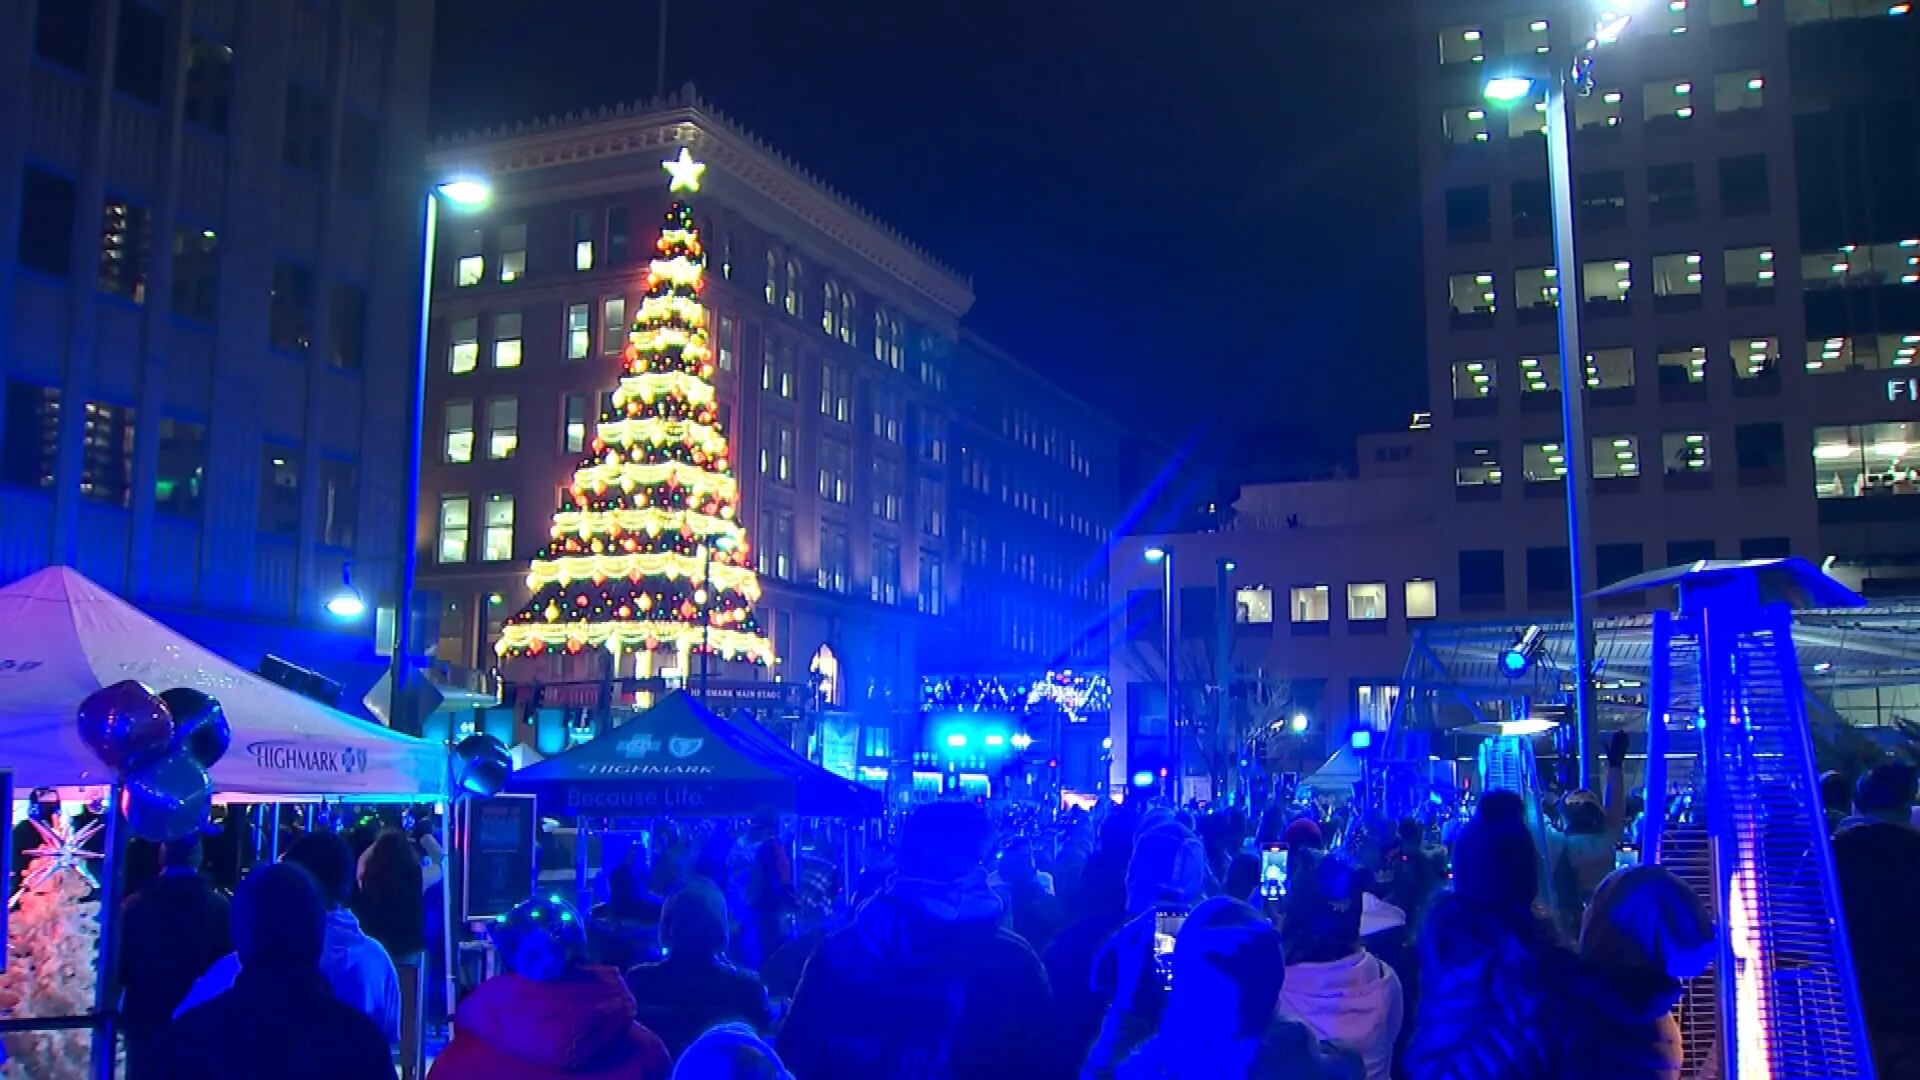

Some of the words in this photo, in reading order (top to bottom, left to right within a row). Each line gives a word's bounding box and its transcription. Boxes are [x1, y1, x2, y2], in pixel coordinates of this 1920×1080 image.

[690, 688, 733, 697] HIHMARK
[735, 689, 755, 698] MAIN
[253, 745, 339, 773] HIGHMARK
[586, 764, 713, 774] HIGHMARK
[567, 787, 658, 806] Because
